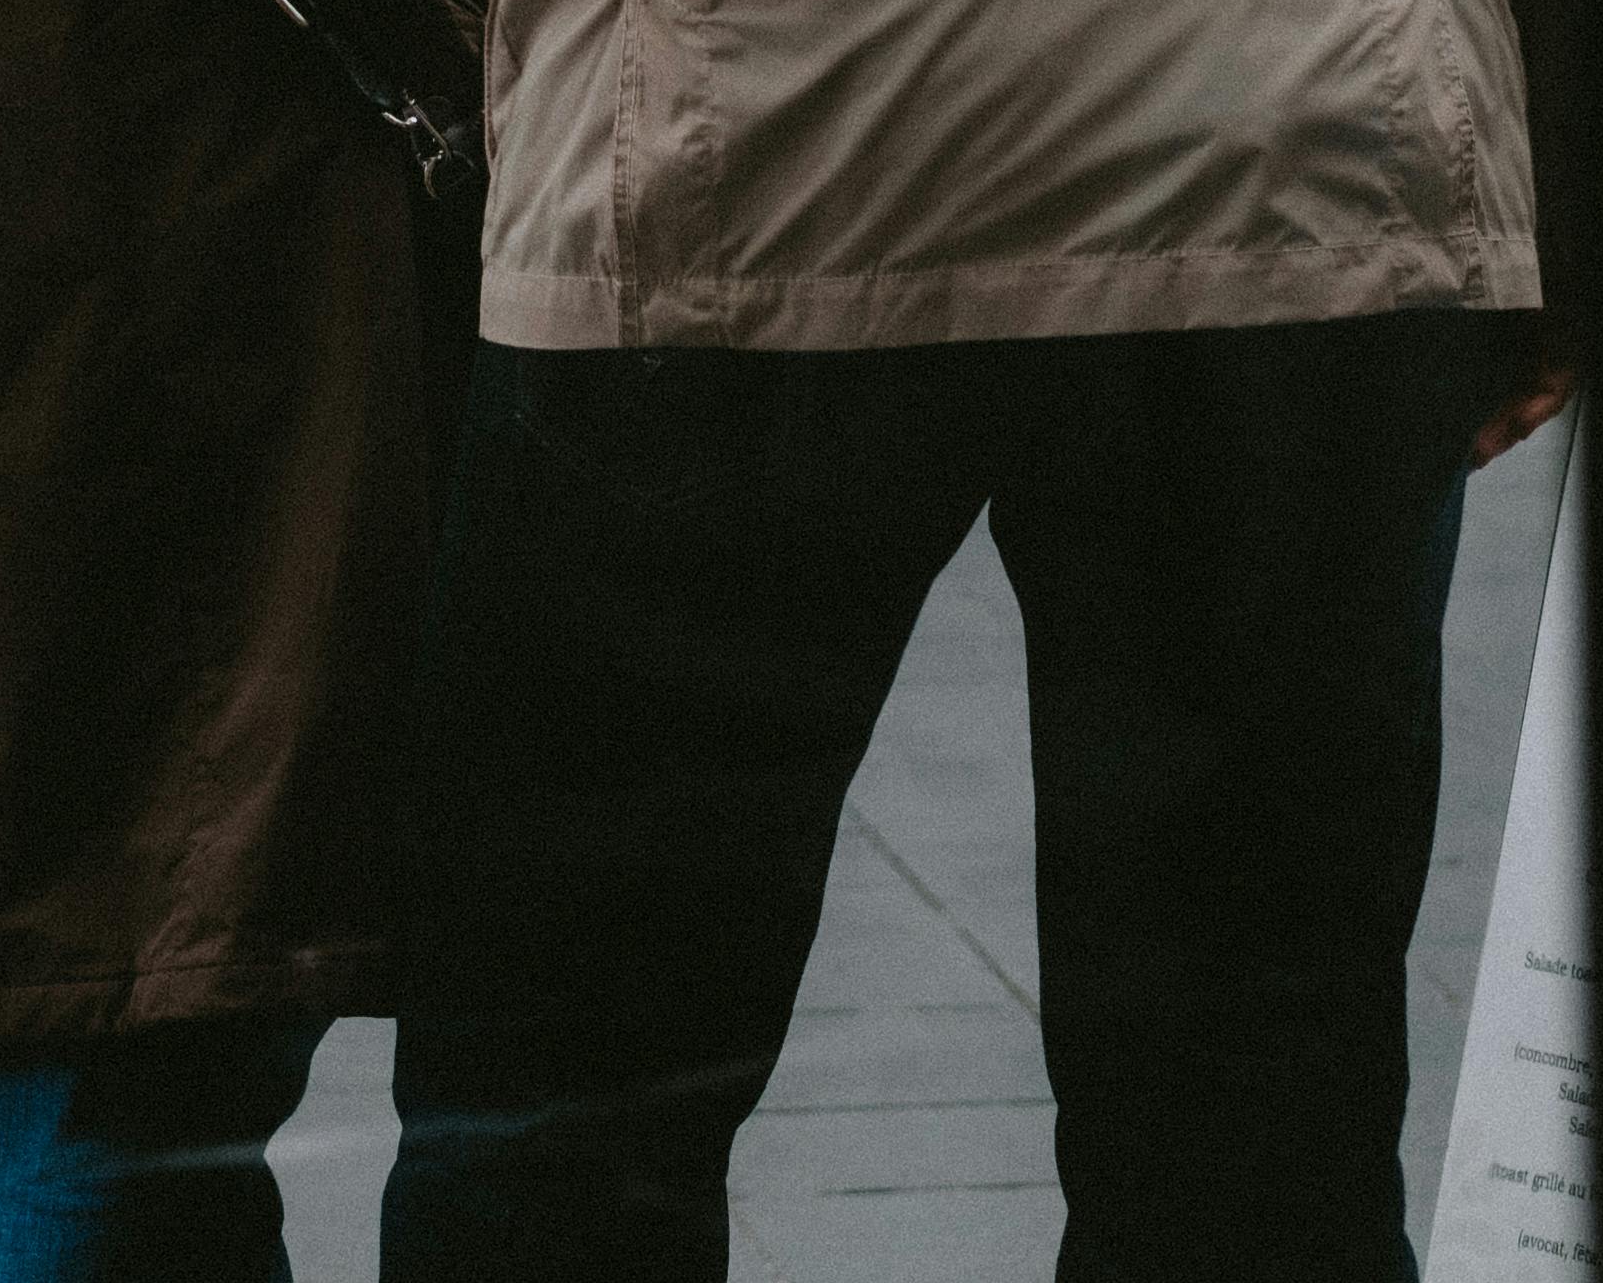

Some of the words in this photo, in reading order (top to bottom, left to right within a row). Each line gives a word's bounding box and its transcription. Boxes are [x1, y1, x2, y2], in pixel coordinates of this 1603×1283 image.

[1524, 950, 1568, 978] Salade
[1568, 1179, 1585, 1200] au
[1518, 1229, 1568, 1261] (avocat,
